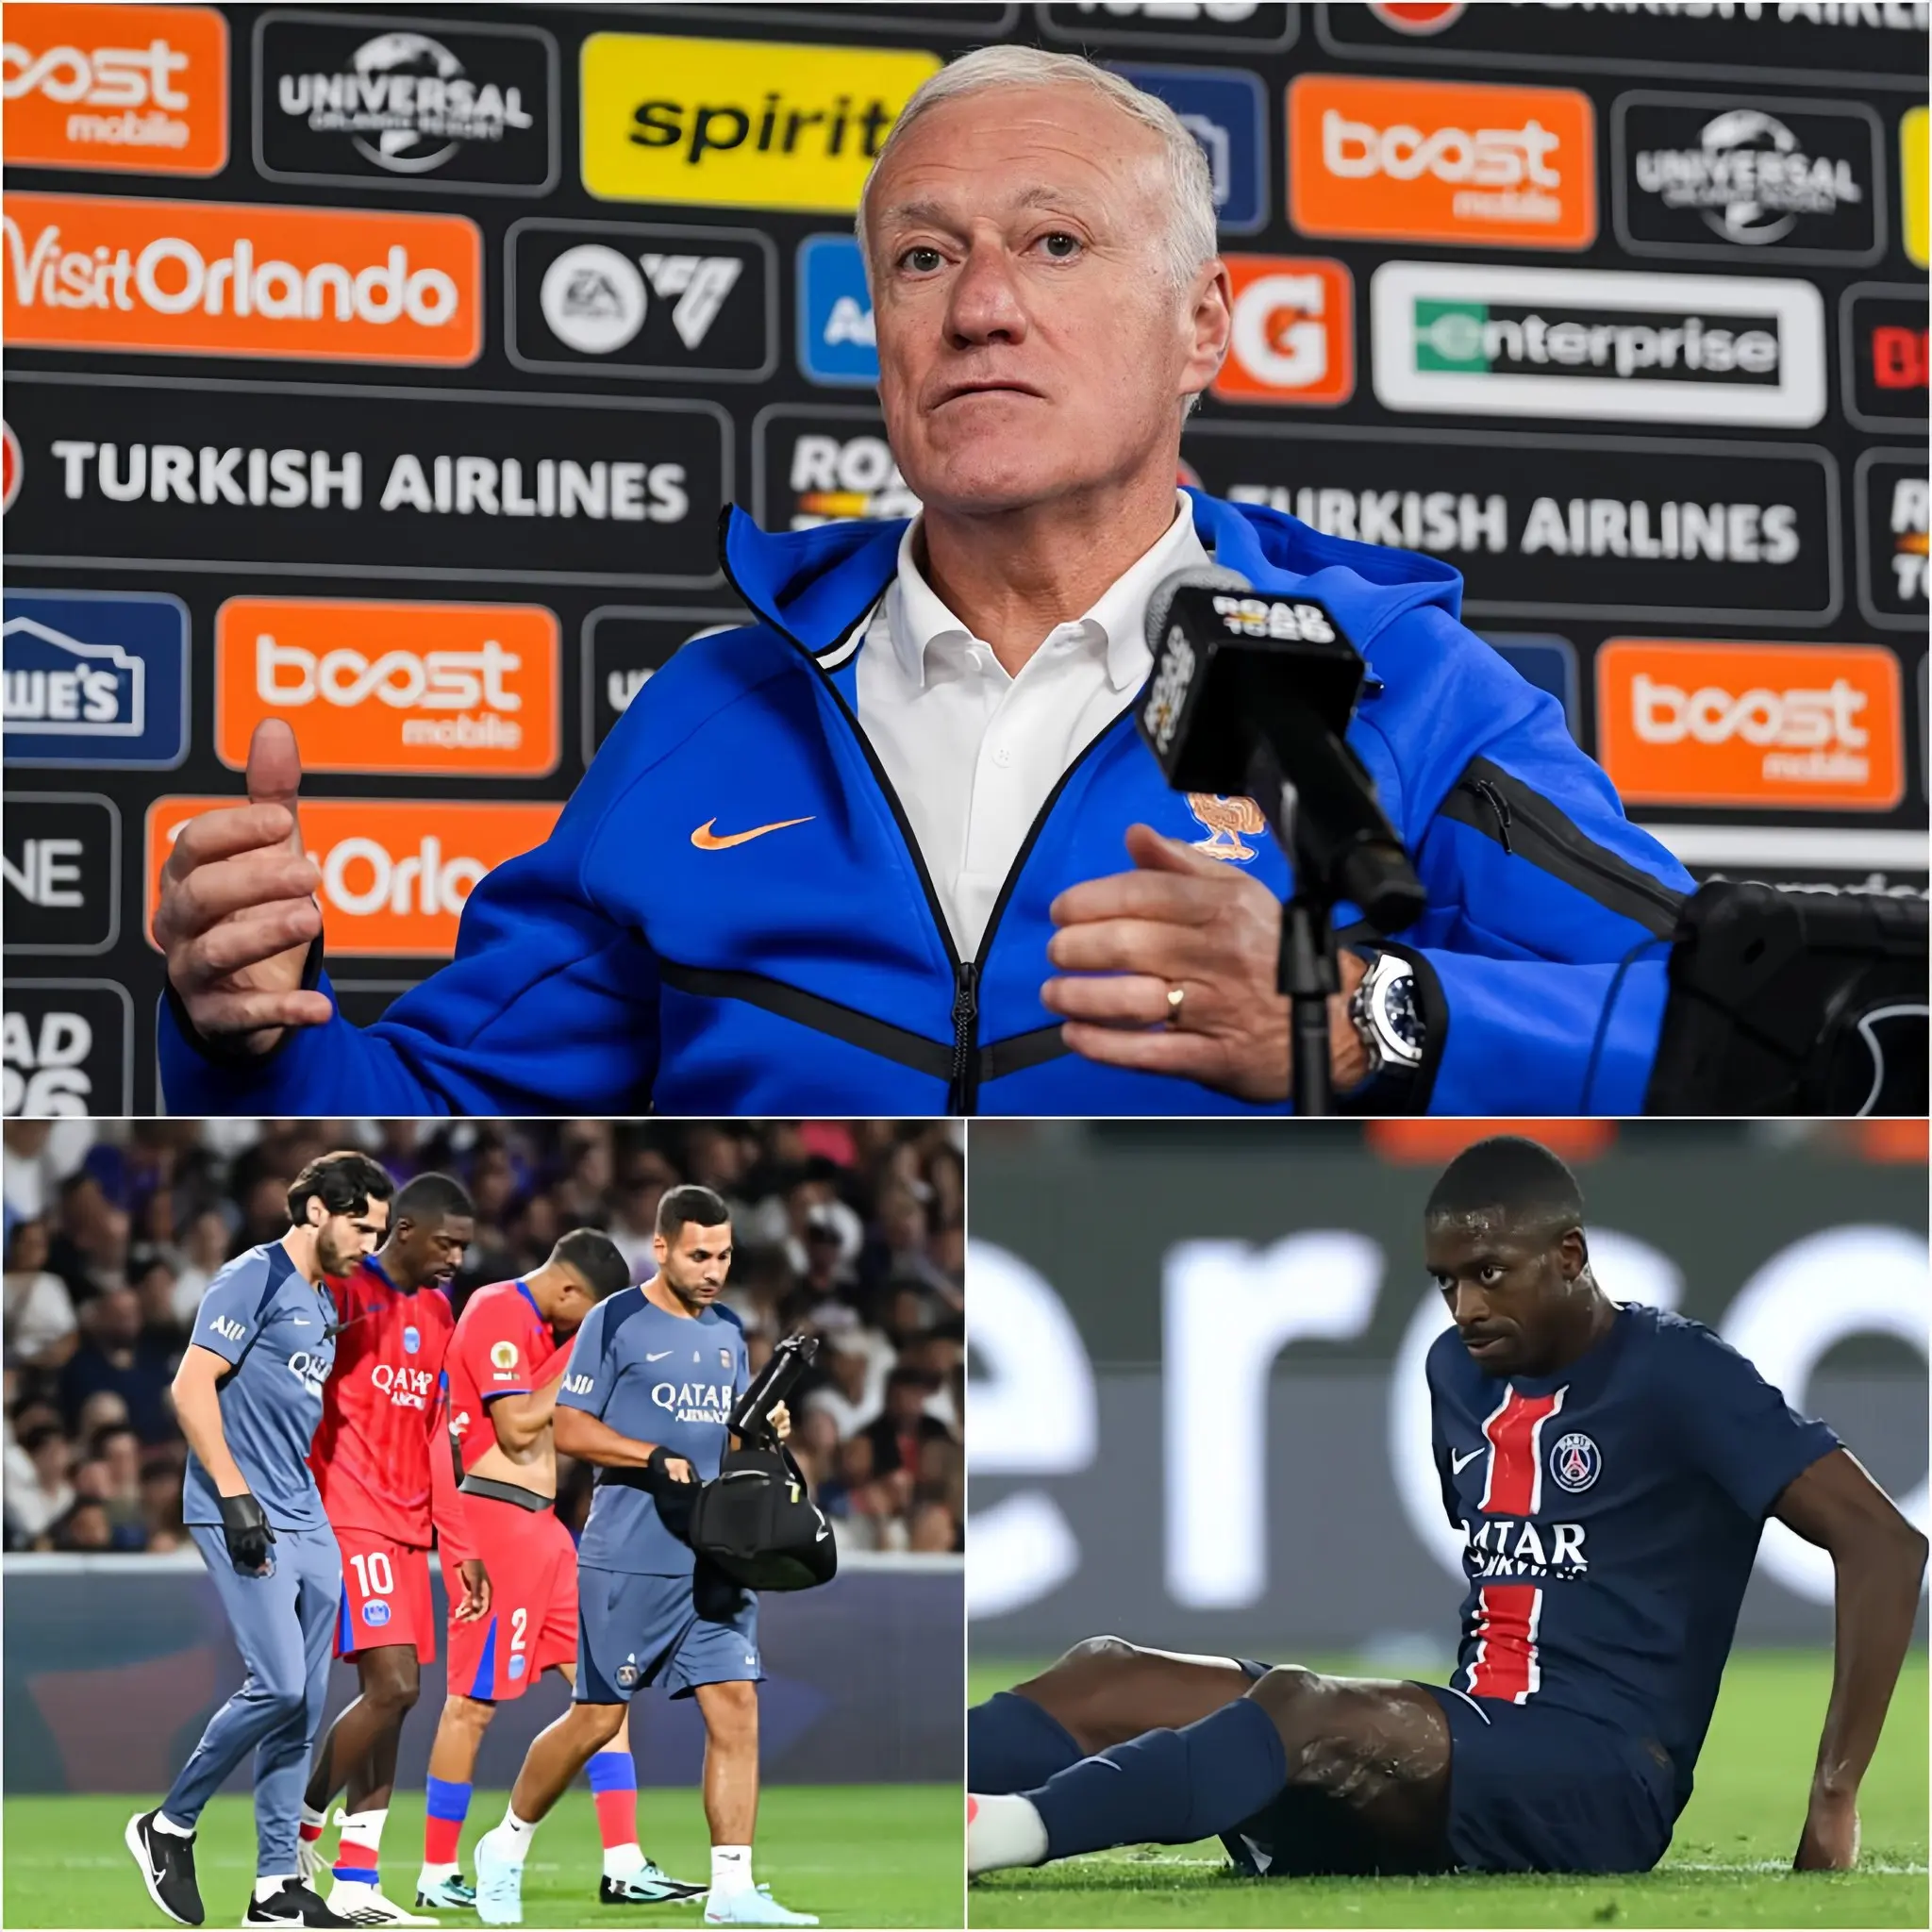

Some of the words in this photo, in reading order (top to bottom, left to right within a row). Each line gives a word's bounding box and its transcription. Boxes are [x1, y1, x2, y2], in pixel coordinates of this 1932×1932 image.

[66, 109, 189, 149] mobile
[278, 73, 533, 129] UNIVERSAL
[628, 92, 891, 165] spirit
[1323, 108, 1561, 188] boost
[1232, 276, 1327, 388] G
[1428, 312, 1778, 377] enterprise
[51, 440, 363, 510] TURKISH
[379, 454, 689, 523] AIRLINES
[791, 435, 907, 492] RO
[1521, 496, 1800, 565] AIRLINES
[256, 633, 523, 711] boost
[402, 710, 523, 750] mobile
[1631, 673, 1871, 748] boost
[350, 1552, 394, 1597] 10
[510, 1607, 527, 1651] 2
